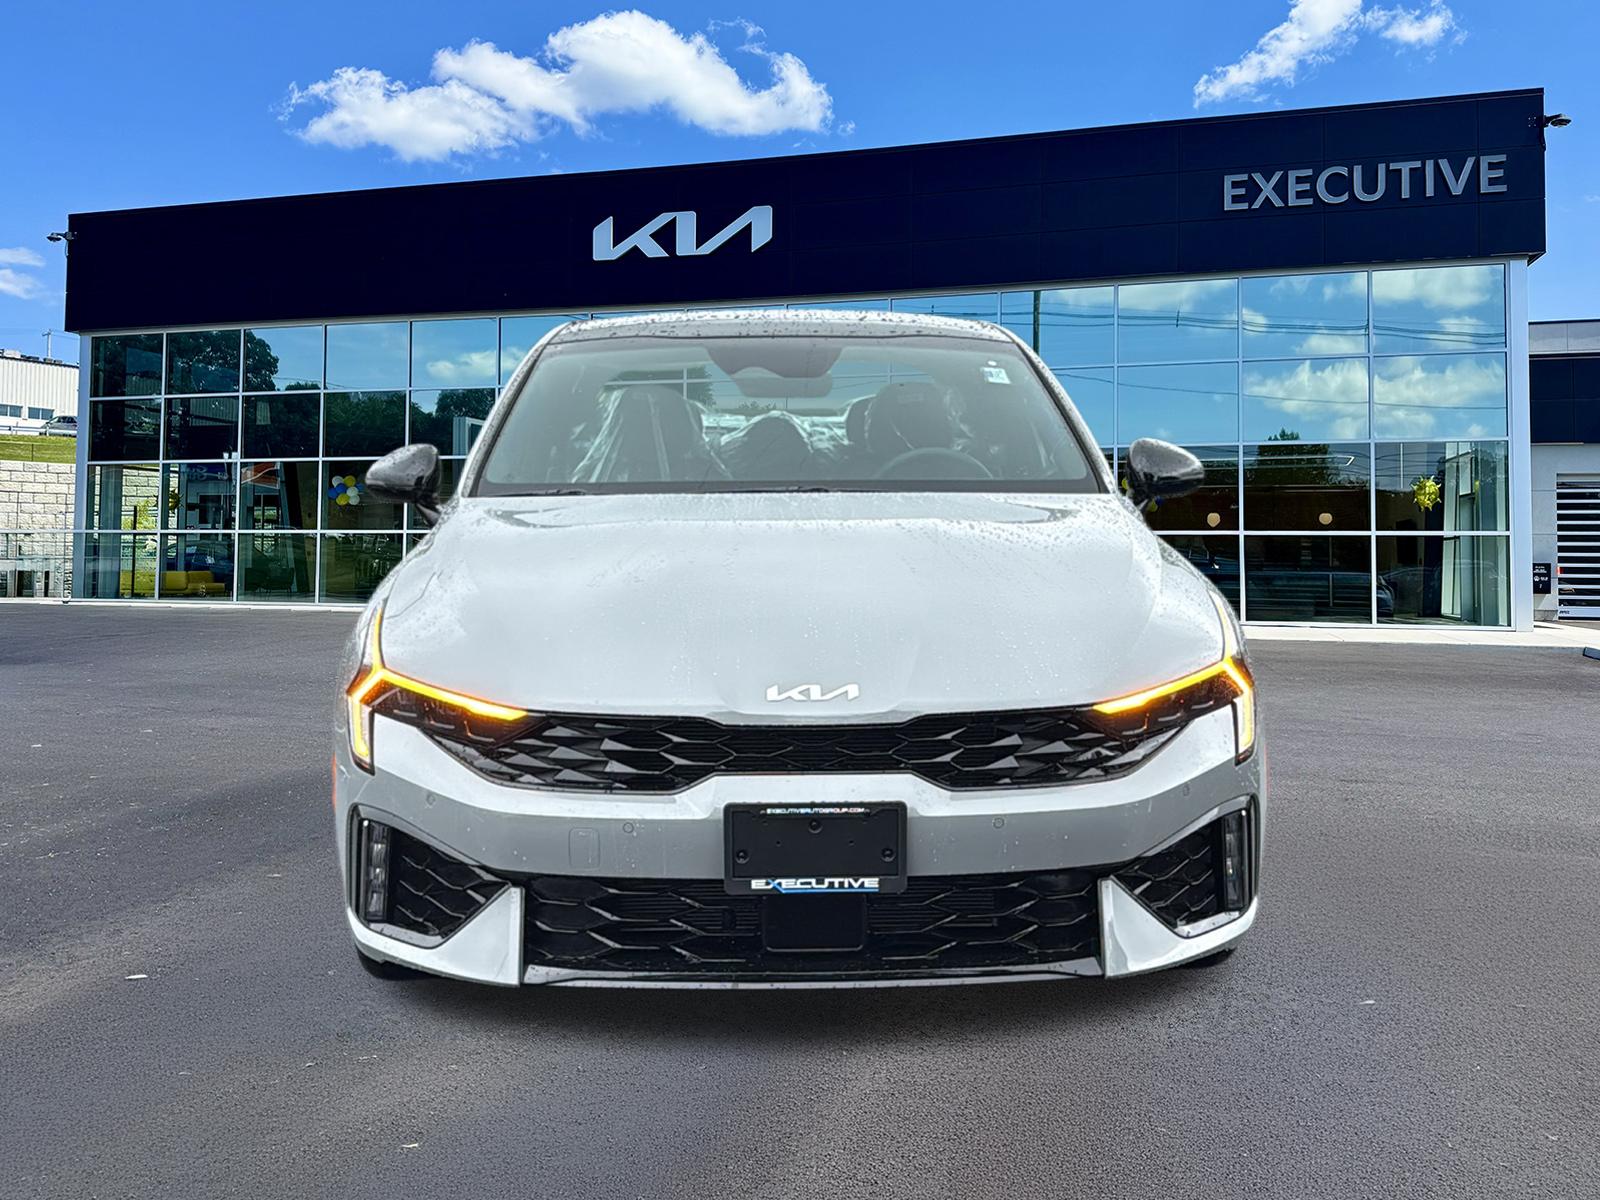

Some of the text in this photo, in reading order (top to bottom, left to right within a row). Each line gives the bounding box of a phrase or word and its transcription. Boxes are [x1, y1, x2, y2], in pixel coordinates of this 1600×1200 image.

[1223, 154, 1508, 211] EXECUTIVE
[593, 205, 773, 261] KIA
[766, 683, 860, 702] KIA
[750, 877, 880, 891] EXECUTIVE
